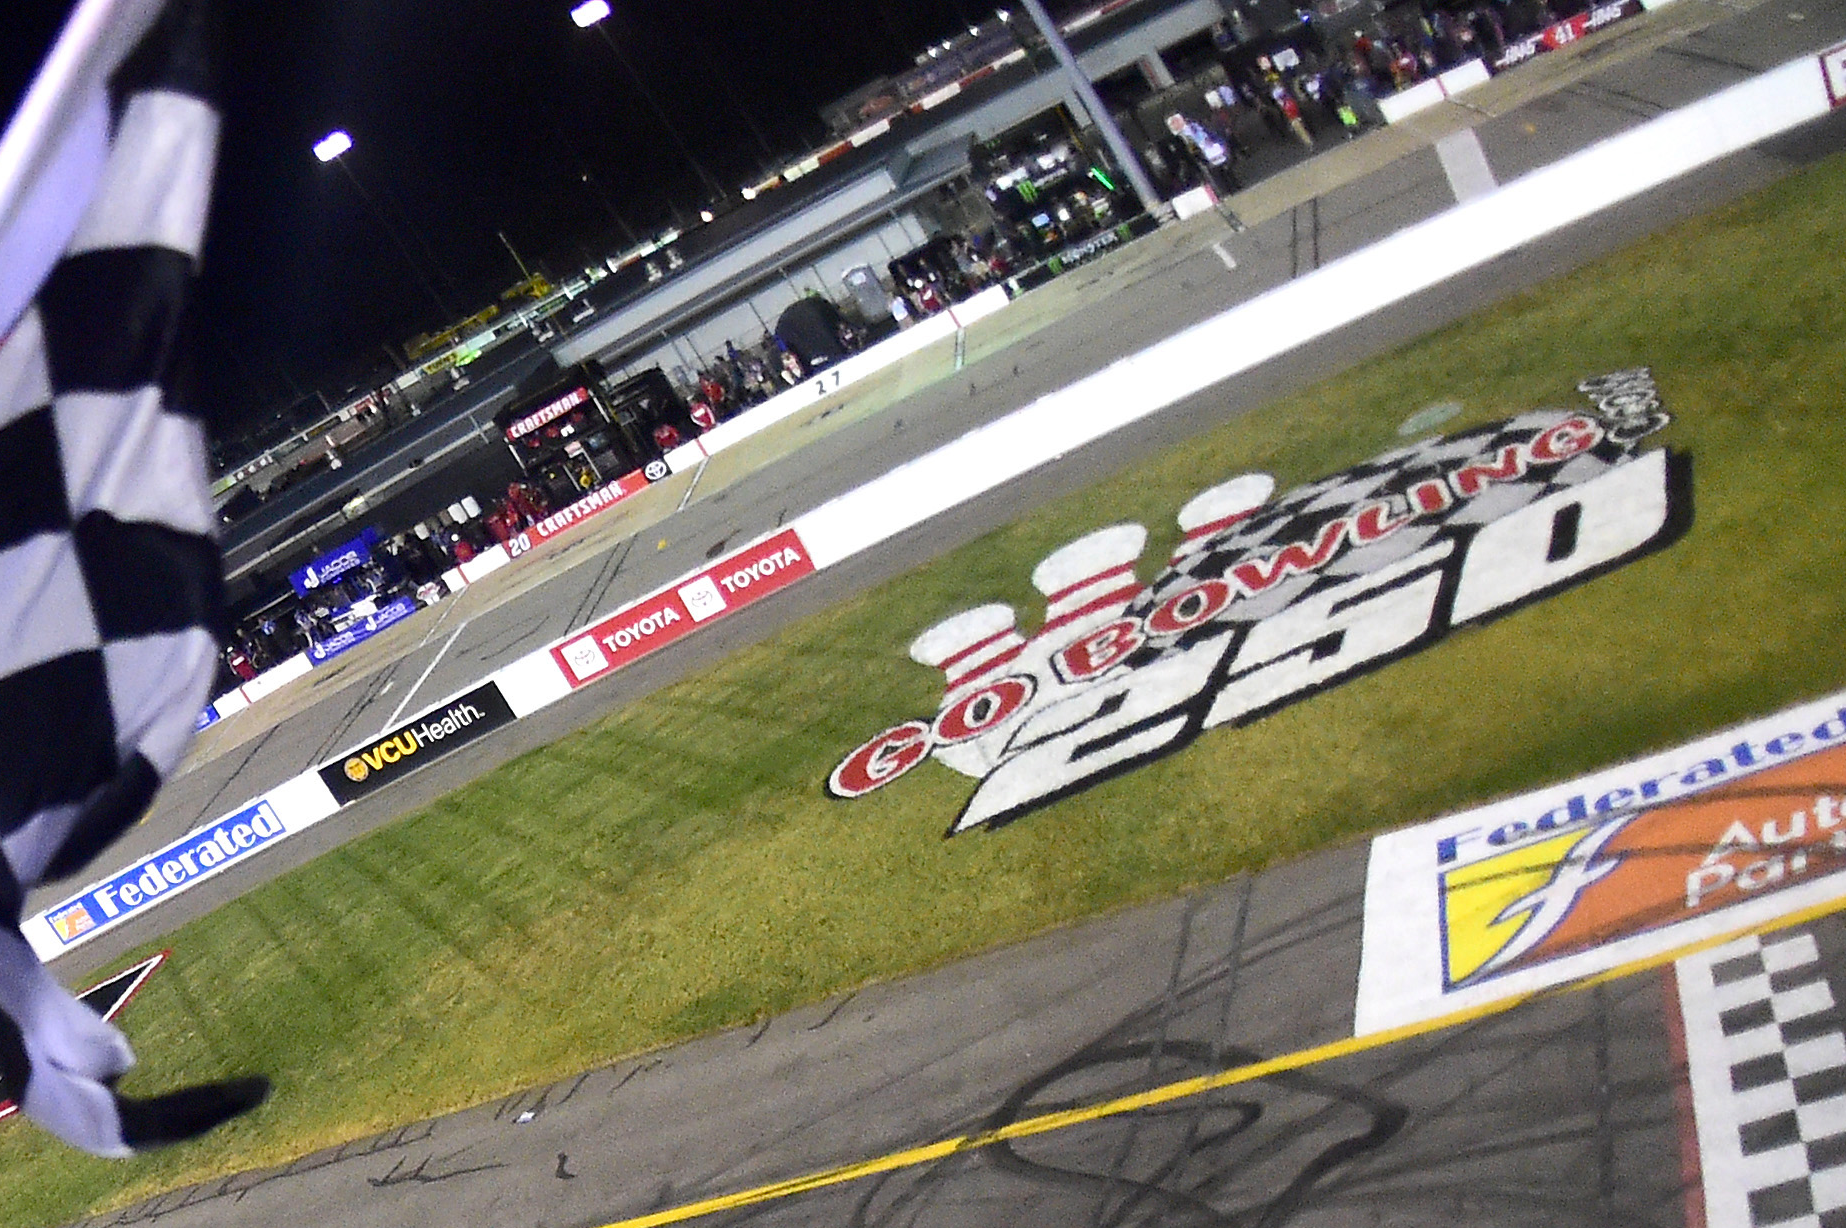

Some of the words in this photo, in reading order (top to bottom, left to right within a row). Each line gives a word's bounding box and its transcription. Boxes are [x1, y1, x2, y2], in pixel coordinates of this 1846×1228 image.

[1554, 20, 1576, 45] 41
[815, 369, 840, 396] 27
[510, 391, 581, 440] CRAFTSMAN
[507, 532, 532, 558] 20
[536, 480, 625, 537] CRAFTSMAN
[720, 546, 801, 594] TOYOTA
[602, 606, 681, 653] TOYOTA
[827, 673, 1038, 799] GO
[1050, 412, 1605, 685] BOWLING
[947, 447, 1668, 838] 250
[92, 802, 284, 918] Federated
